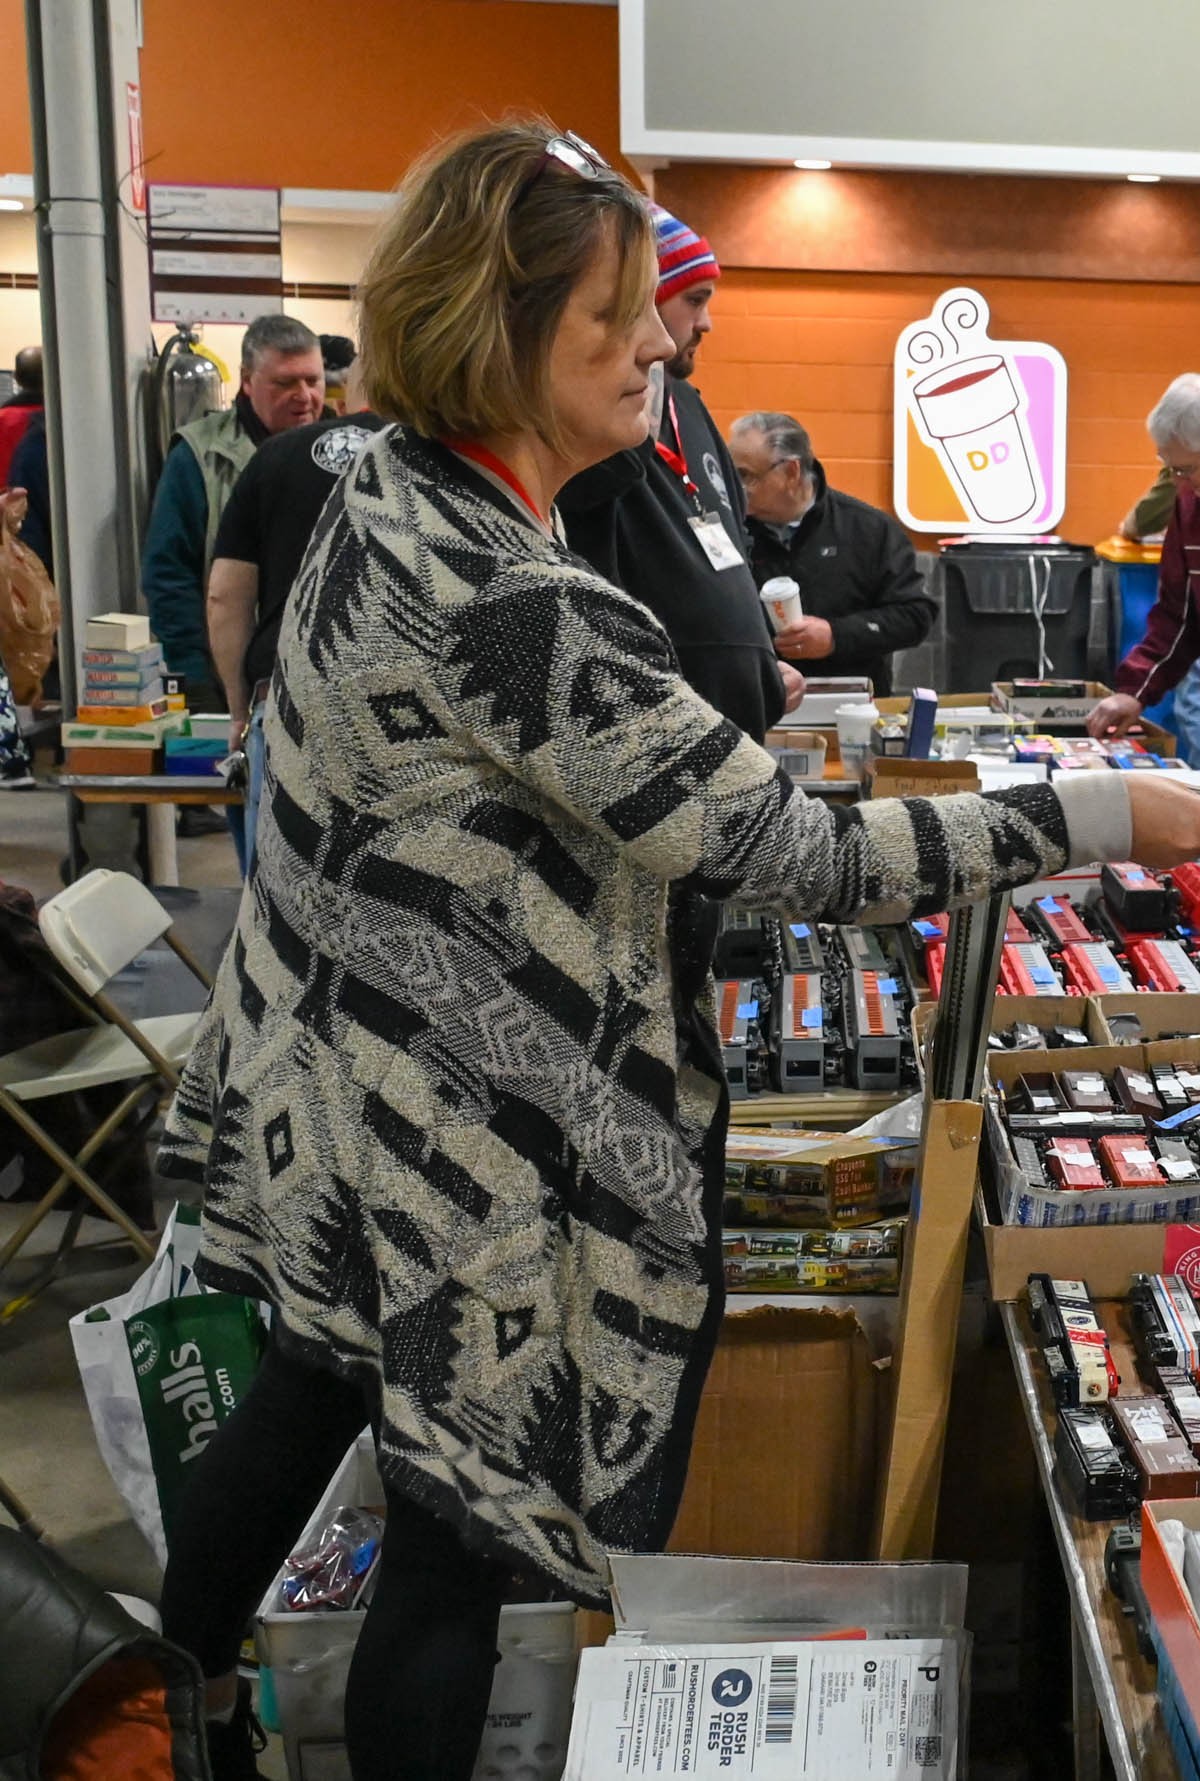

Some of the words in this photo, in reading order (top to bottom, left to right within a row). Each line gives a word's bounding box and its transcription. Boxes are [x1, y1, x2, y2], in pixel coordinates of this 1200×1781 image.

[1179, 1252, 1197, 1272] KING
[642, 1666, 651, 1693] CUSTOM
[918, 1667, 940, 1682] P
[900, 1679, 908, 1709] PRIORITY
[638, 1695, 647, 1727] T-SHIRTS
[680, 1664, 699, 1771] RUSHORDERTEES.COM
[899, 1710, 907, 1726] MAIL
[708, 1712, 722, 1751] TEES
[720, 1712, 735, 1767] ORDER
[734, 1712, 748, 1754] RUSH
[633, 1736, 642, 1767] APPAREL
